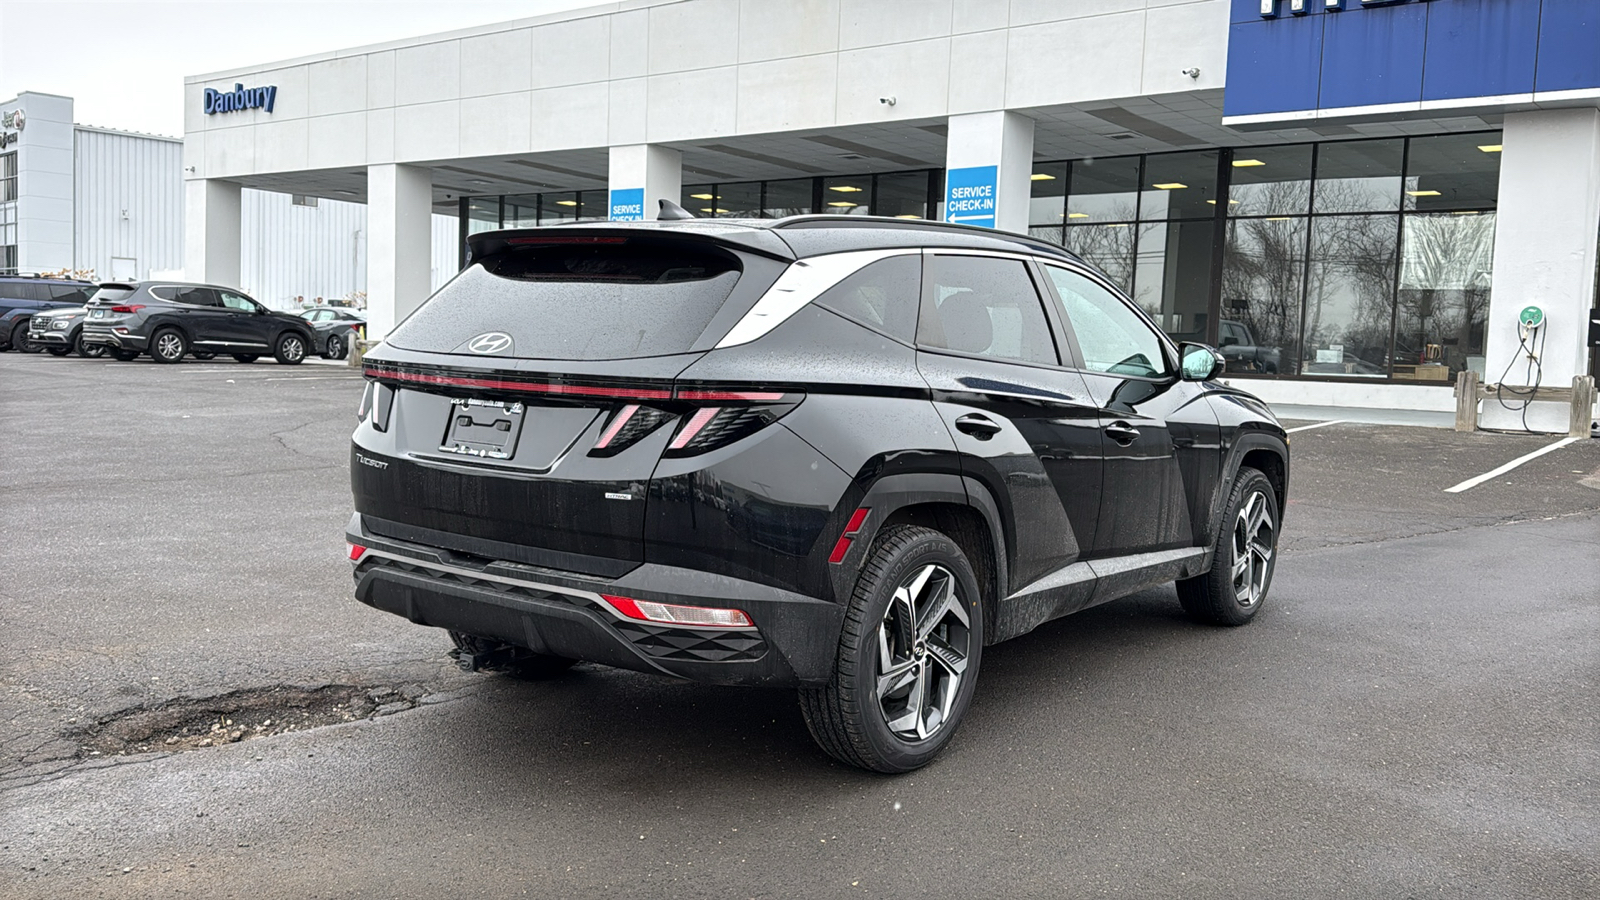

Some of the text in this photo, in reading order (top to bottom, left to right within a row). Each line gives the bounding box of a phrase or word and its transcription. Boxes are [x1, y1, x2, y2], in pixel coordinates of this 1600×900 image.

[204, 83, 277, 115] Danbury
[951, 185, 992, 199] SERVICE
[612, 204, 641, 215] SERVICE
[948, 198, 994, 212] CHECK-IN
[902, 543, 929, 565] SPORT
